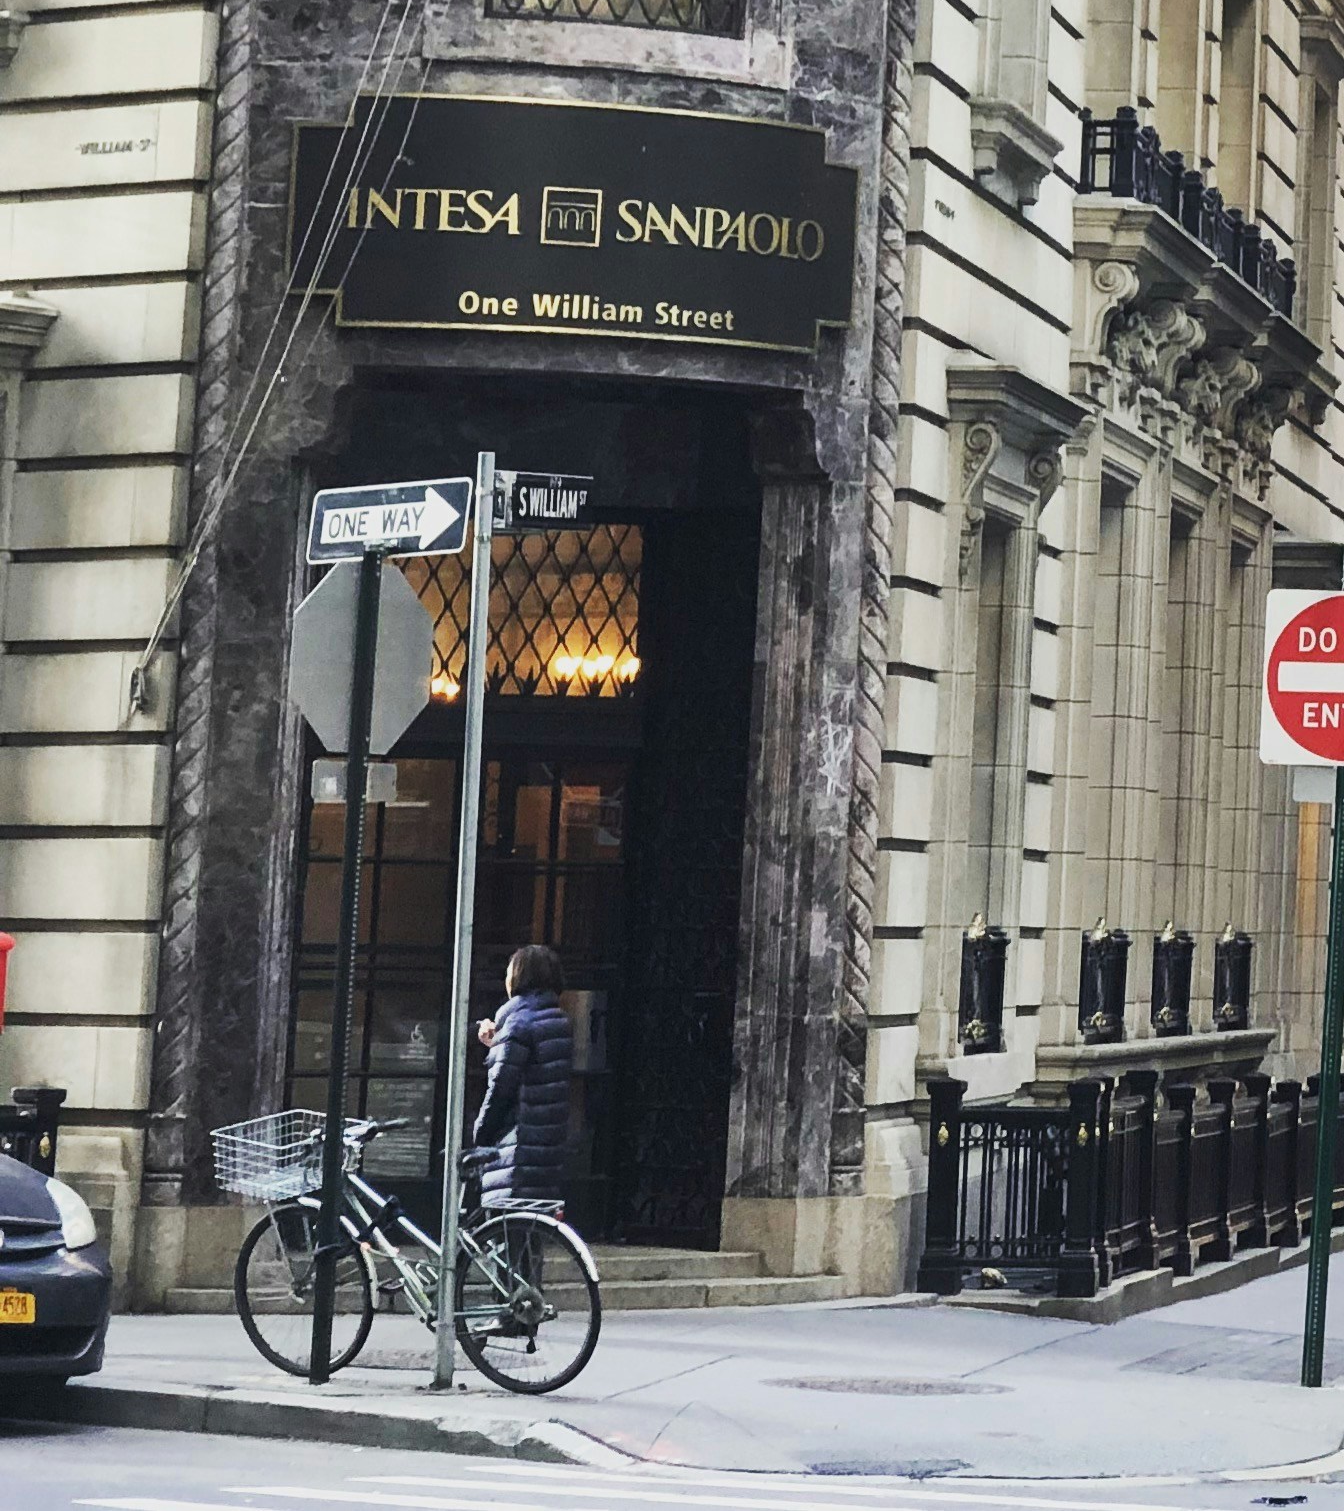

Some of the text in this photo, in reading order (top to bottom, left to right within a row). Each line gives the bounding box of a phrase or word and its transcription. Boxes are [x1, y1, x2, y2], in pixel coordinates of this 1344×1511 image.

[346, 187, 824, 261] INTESA SANPAOLO
[458, 289, 734, 331] One William Street
[518, 486, 528, 517] S
[529, 487, 578, 519] WILLIAM
[328, 506, 425, 538] ONE WAY
[1298, 626, 1338, 653] DO
